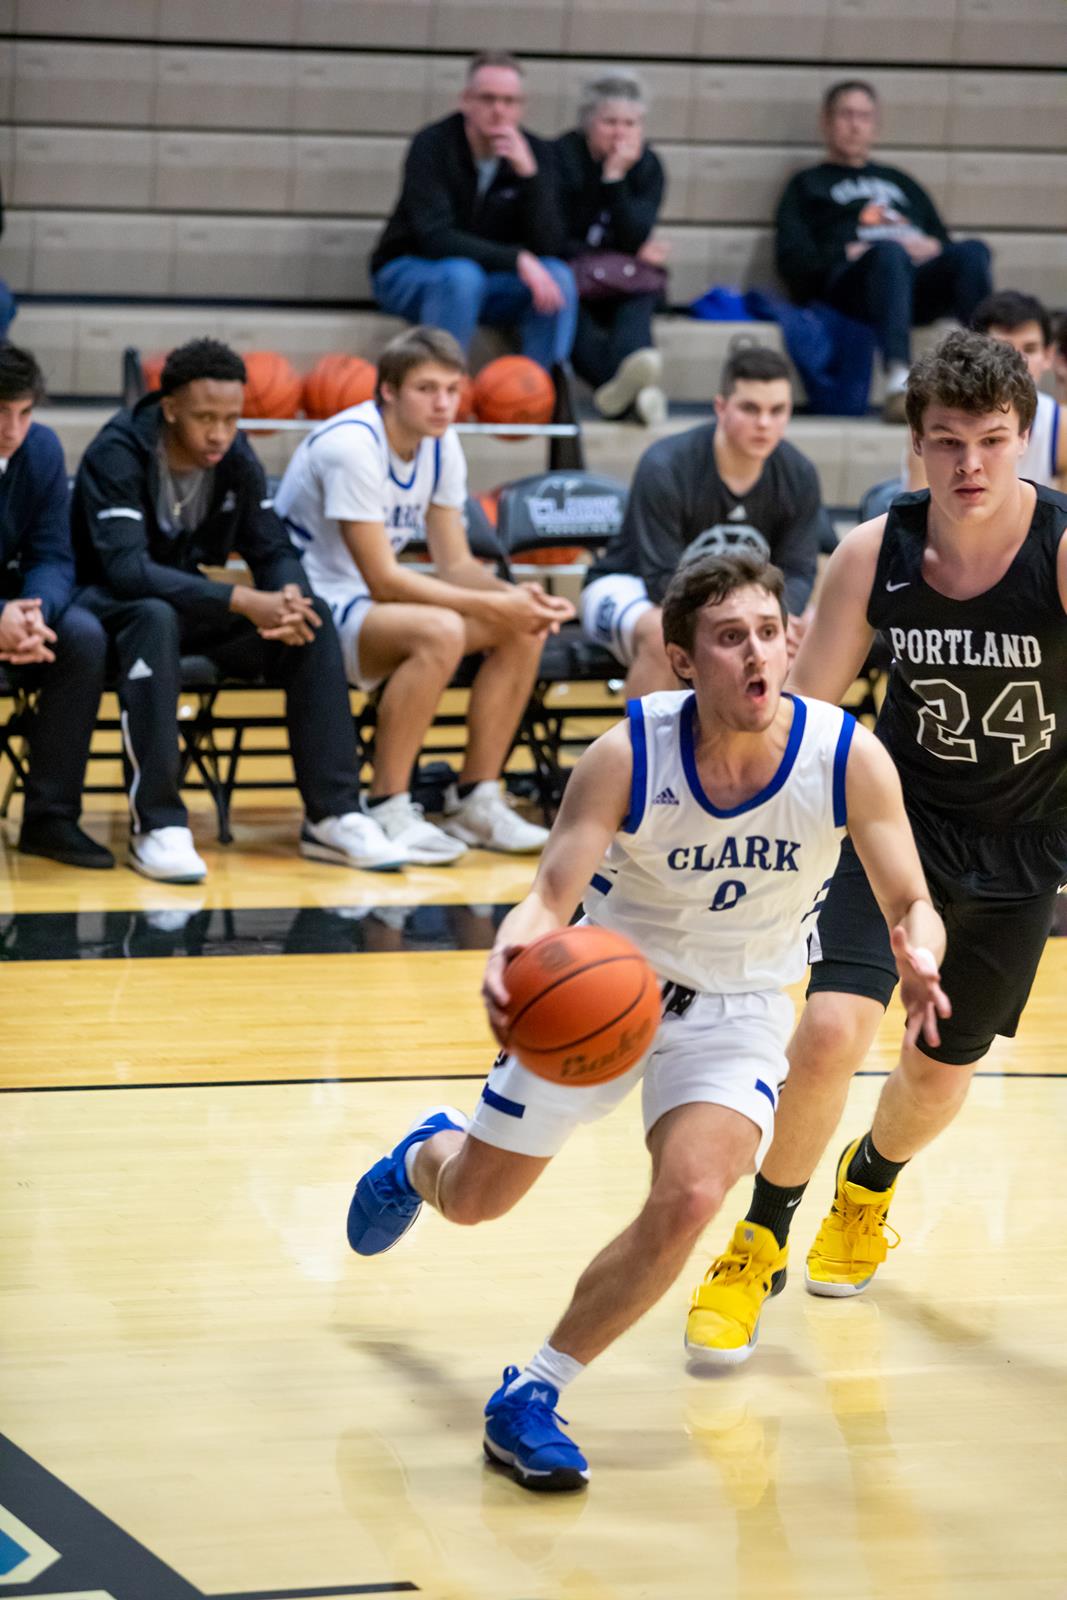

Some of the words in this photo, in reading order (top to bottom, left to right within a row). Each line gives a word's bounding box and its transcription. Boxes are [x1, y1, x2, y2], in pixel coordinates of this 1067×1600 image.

[889, 627, 1042, 668] PORTLAND
[910, 678, 1056, 765] 24
[667, 835, 802, 872] CLARK
[708, 880, 747, 912] 0
